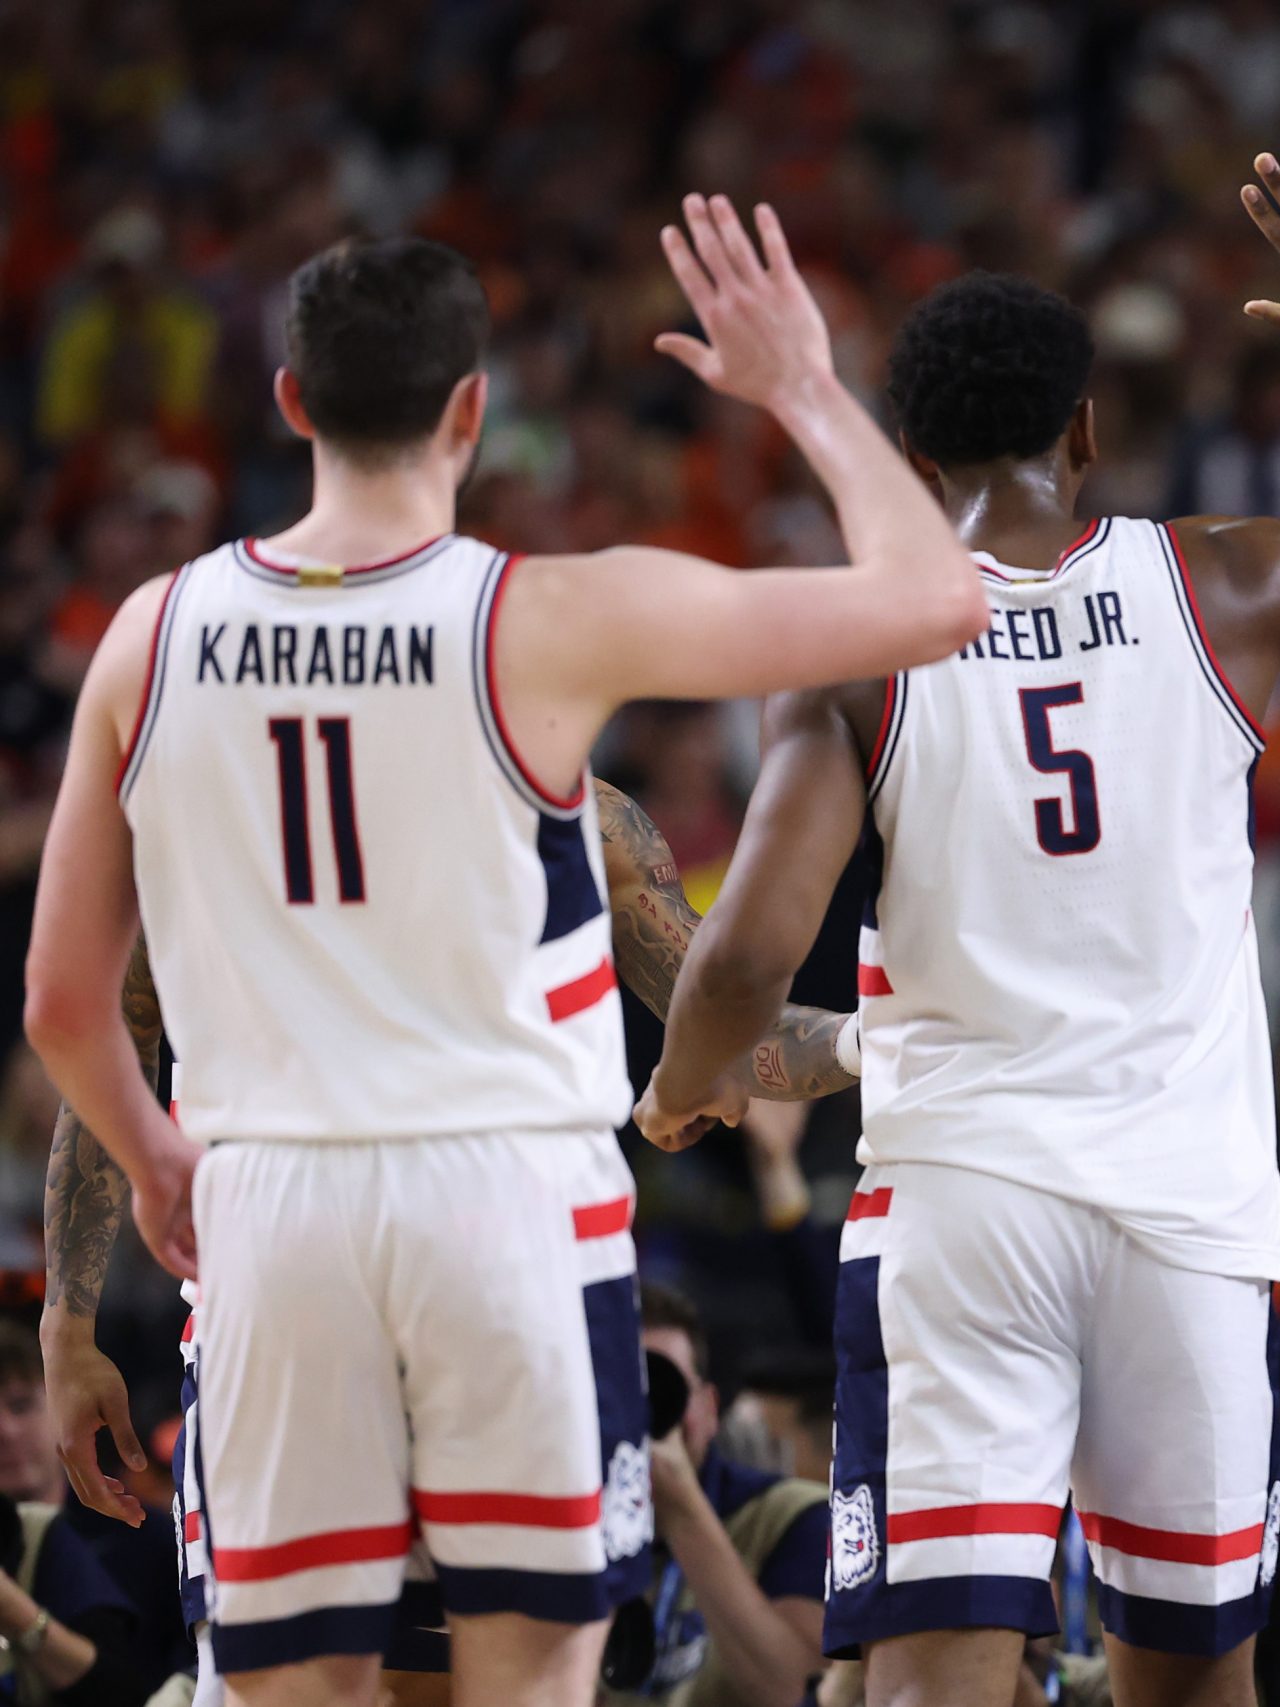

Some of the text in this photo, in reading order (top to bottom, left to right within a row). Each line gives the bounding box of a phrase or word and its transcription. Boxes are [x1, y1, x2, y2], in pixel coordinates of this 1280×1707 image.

[197, 623, 434, 685] KARABAN
[1079, 592, 1139, 651] JR.
[268, 715, 366, 905] 11
[1018, 681, 1101, 857] 5
